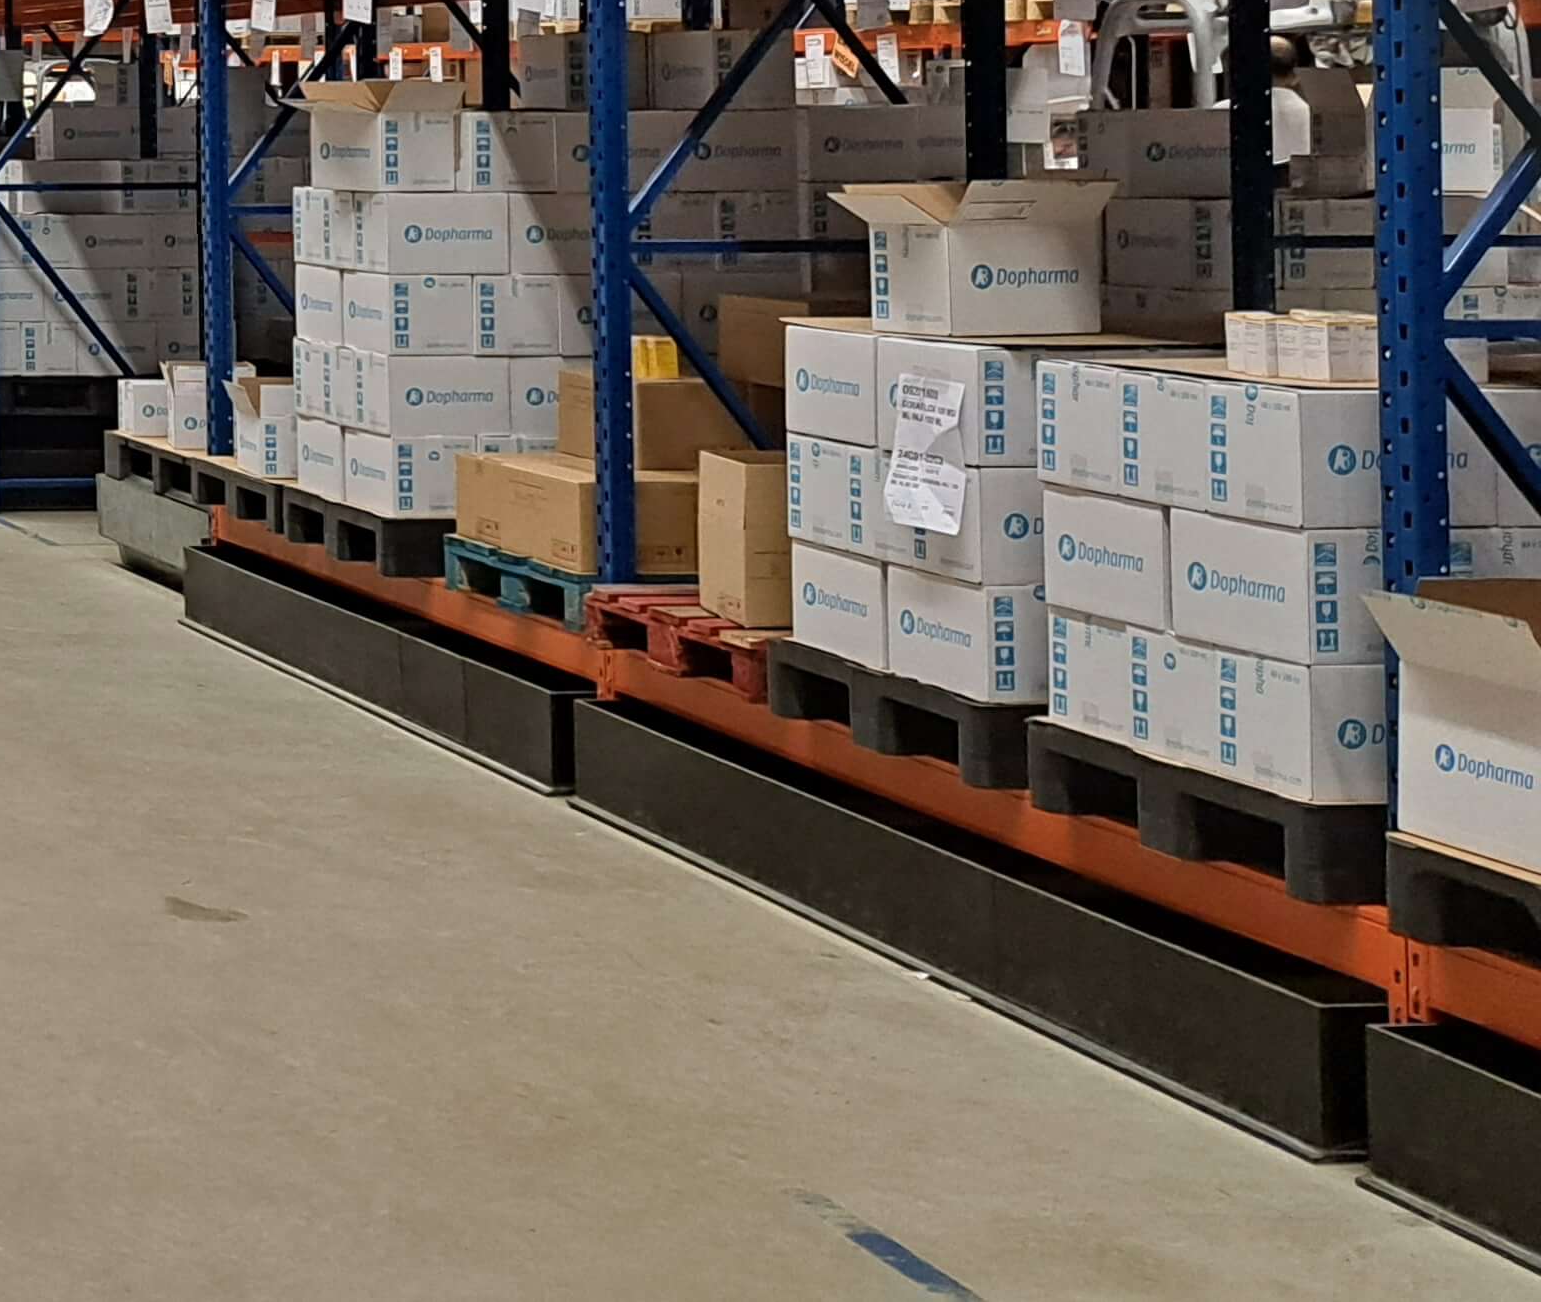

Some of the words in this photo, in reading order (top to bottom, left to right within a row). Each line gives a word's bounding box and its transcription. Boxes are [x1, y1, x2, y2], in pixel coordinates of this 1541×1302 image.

[331, 145, 371, 160] Dopharma
[424, 226, 493, 244] Dopharma
[996, 266, 1080, 289] Dopharma
[426, 387, 494, 407] Dopharma
[810, 372, 861, 397] Dopharma
[1077, 540, 1145, 573] Dopharma
[1209, 569, 1286, 604] Dopharma
[817, 589, 868, 618] Dopharma
[916, 616, 972, 648] Dopharma
[1456, 751, 1535, 792] Dopharma
